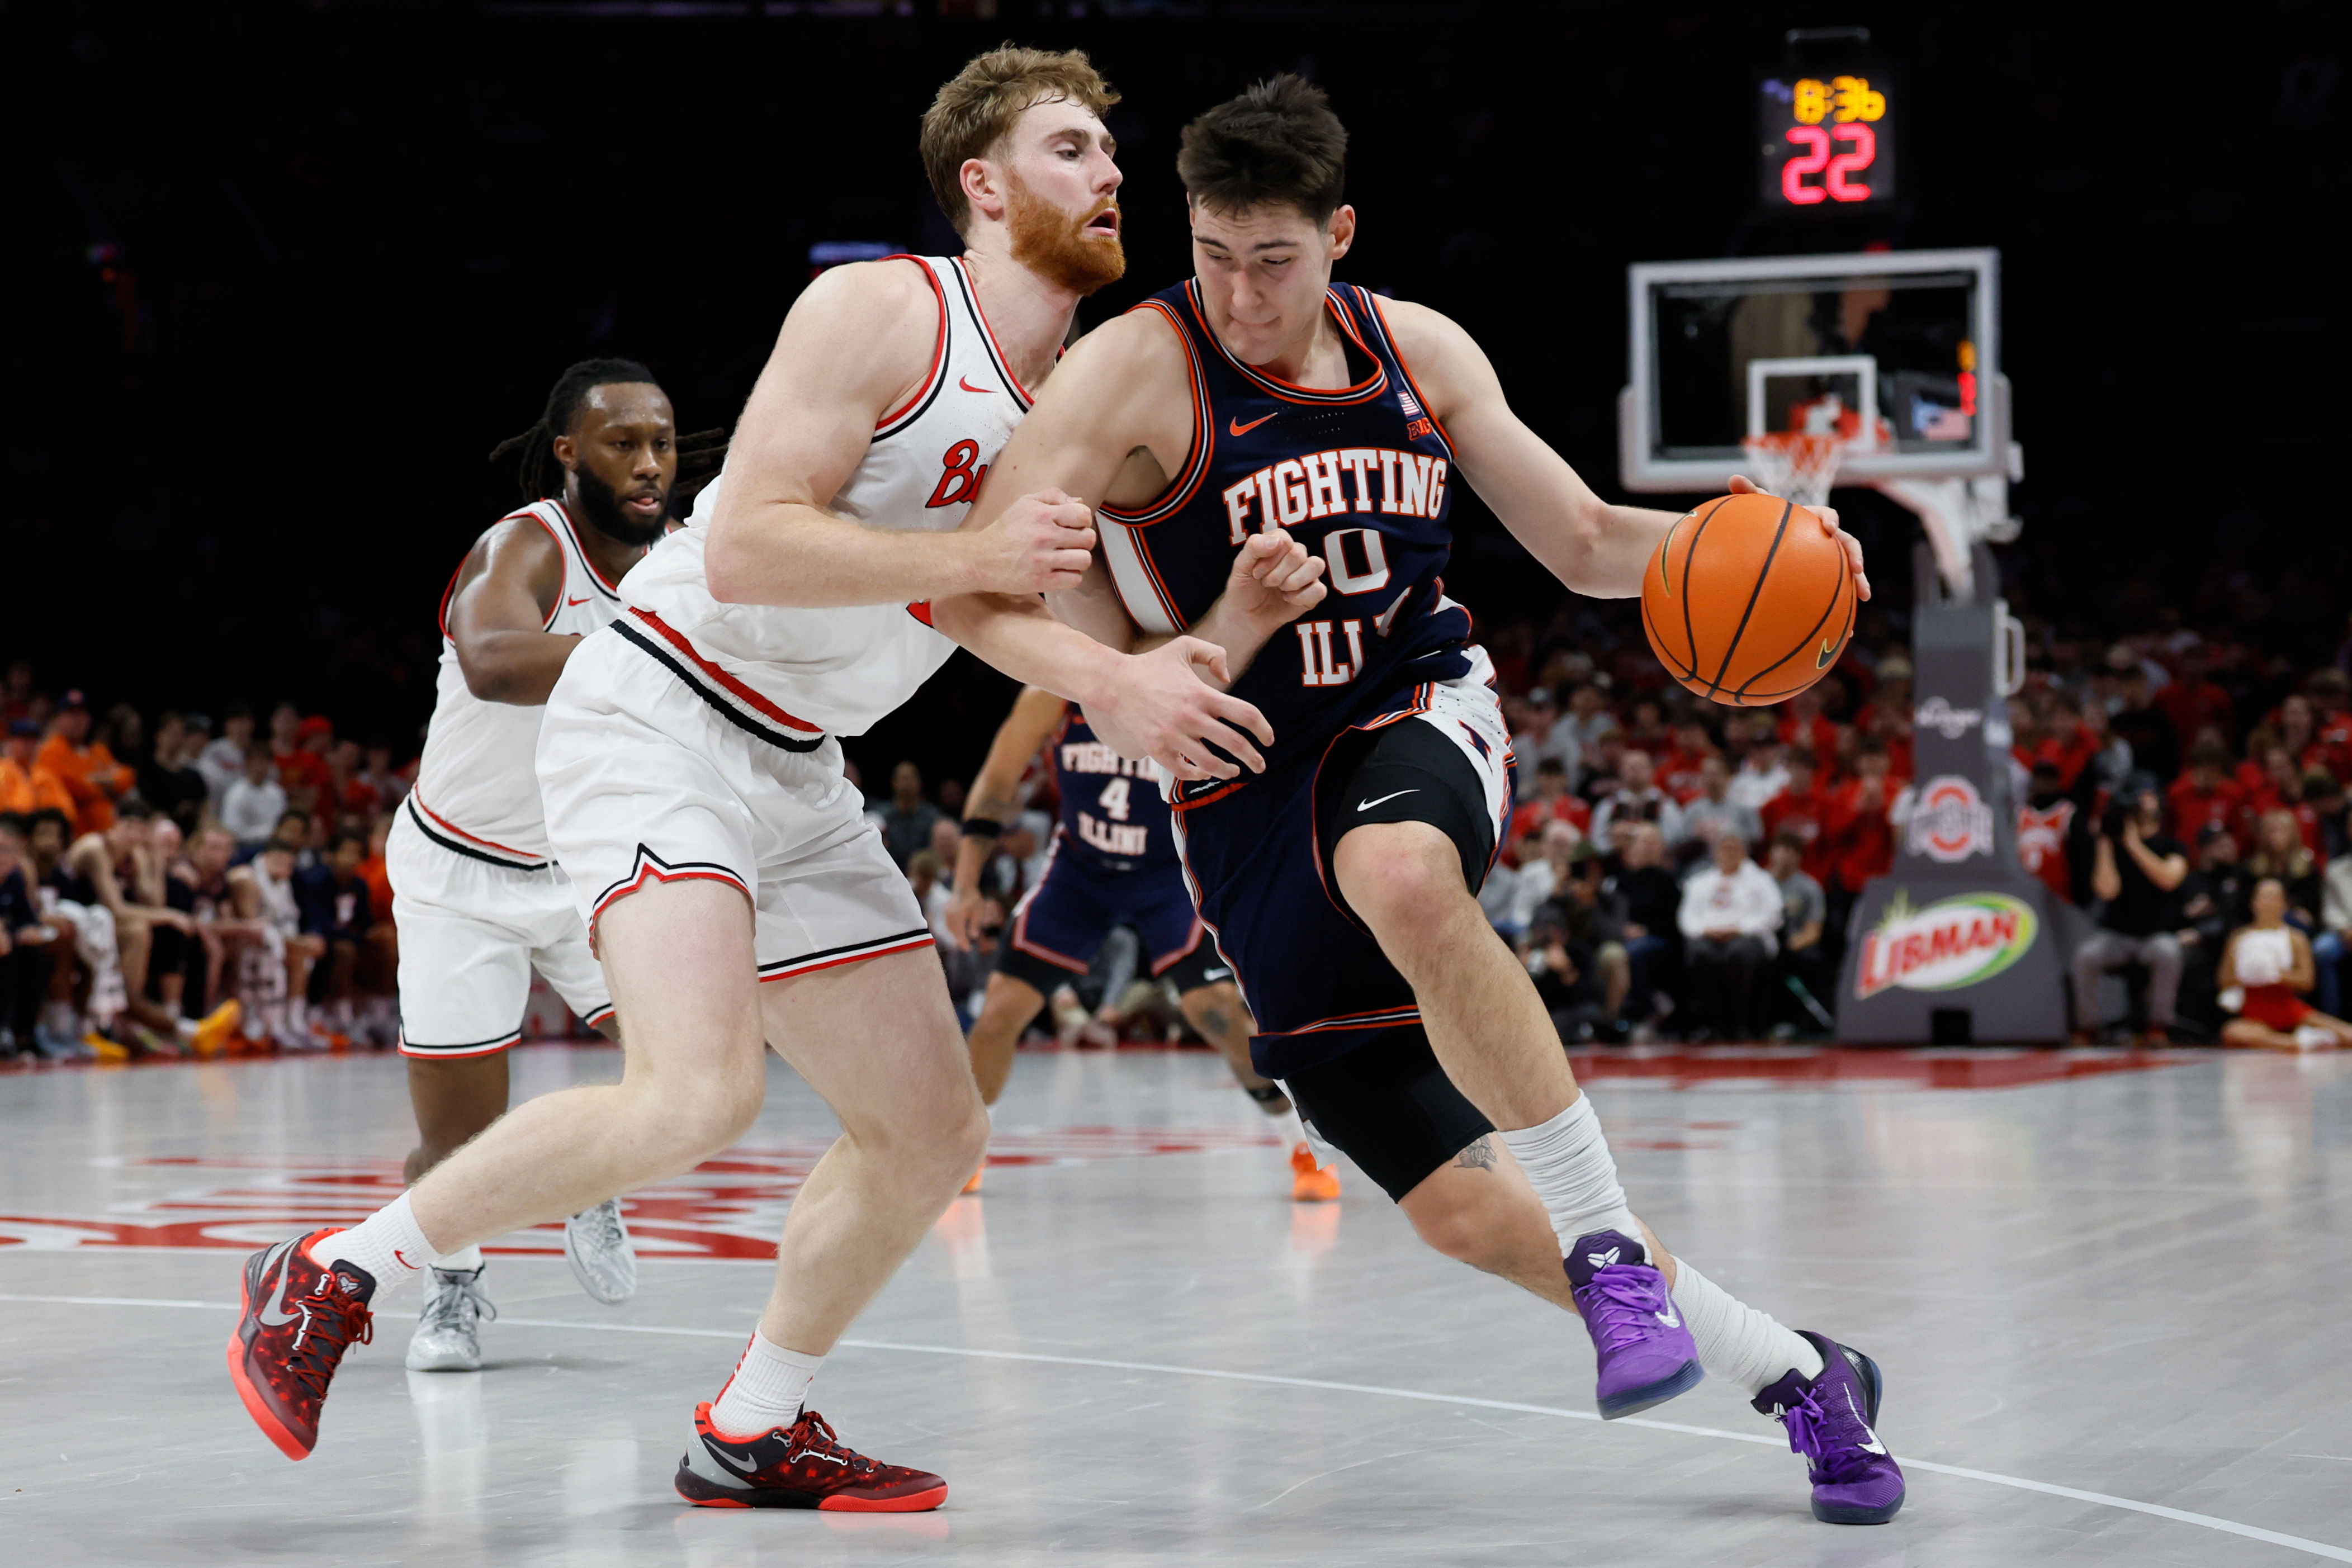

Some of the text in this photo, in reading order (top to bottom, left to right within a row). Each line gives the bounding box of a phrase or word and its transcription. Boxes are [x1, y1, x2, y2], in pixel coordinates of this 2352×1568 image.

[1793, 75, 1886, 124] 8:36
[1782, 122, 1876, 205] 22
[1222, 447, 1447, 547] FIGHTING
[1098, 776, 1130, 821] 4
[1077, 811, 1148, 856] ILLINI
[1857, 911, 2018, 993] LIBMAN
